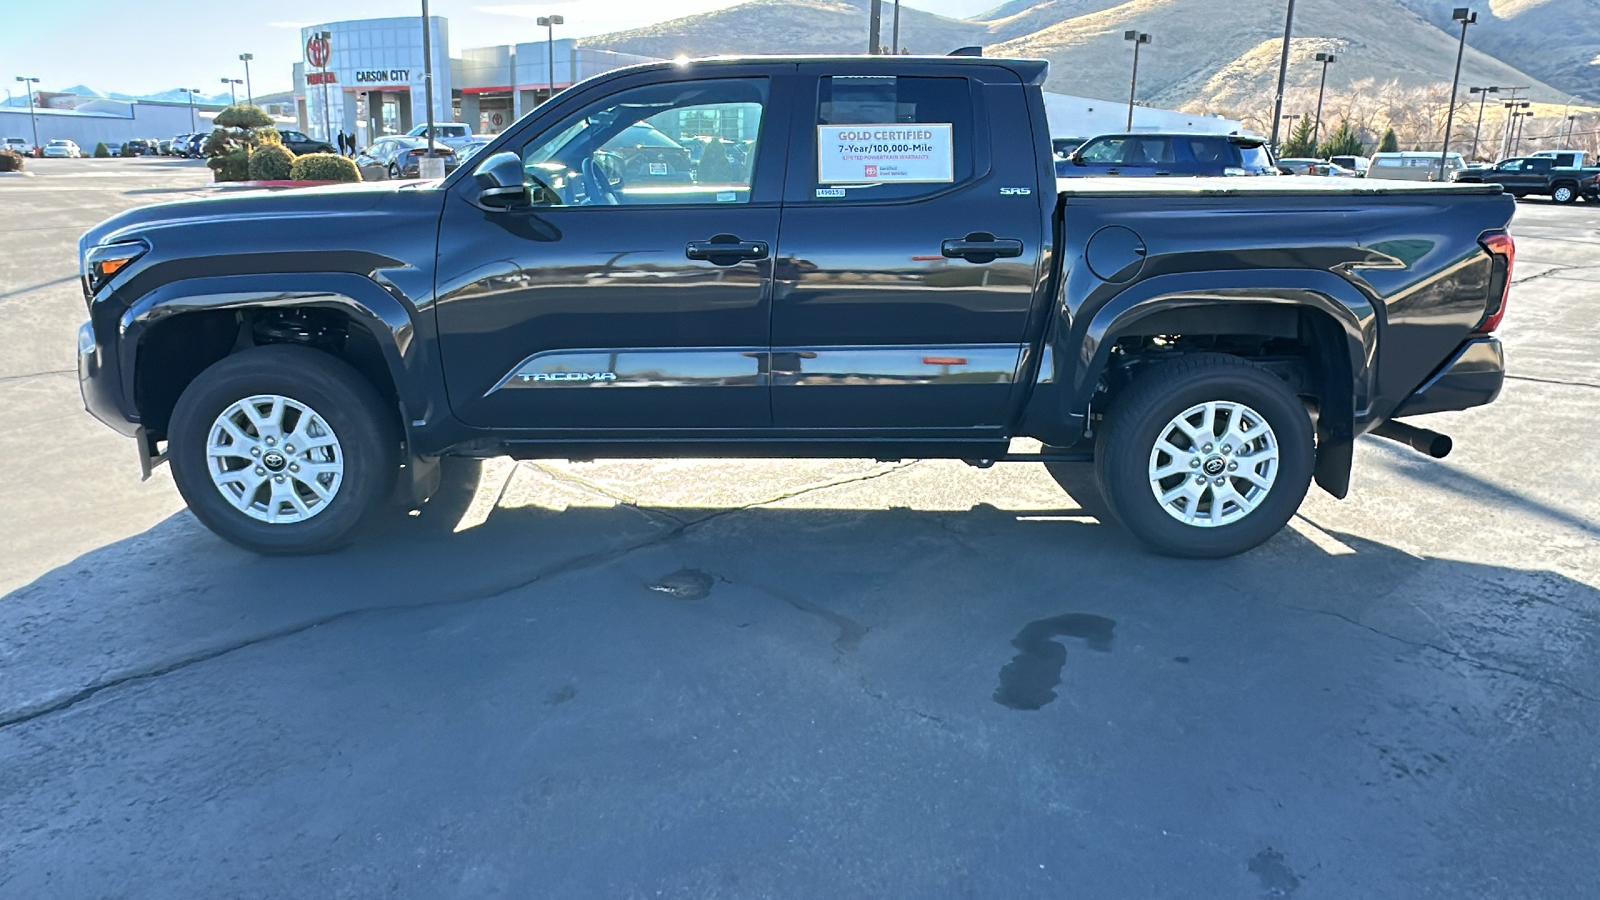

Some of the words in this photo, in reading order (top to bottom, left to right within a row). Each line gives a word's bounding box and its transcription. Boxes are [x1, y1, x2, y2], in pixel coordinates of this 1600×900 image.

[356, 70, 388, 82] CARSON
[390, 70, 410, 81] CITY
[838, 131, 872, 141] GOLD
[874, 130, 933, 140] CERTIFIED
[838, 144, 933, 153] 7-Year/100,000-Mile
[1000, 187, 1031, 195] SR5
[518, 372, 617, 381] TACOMA
